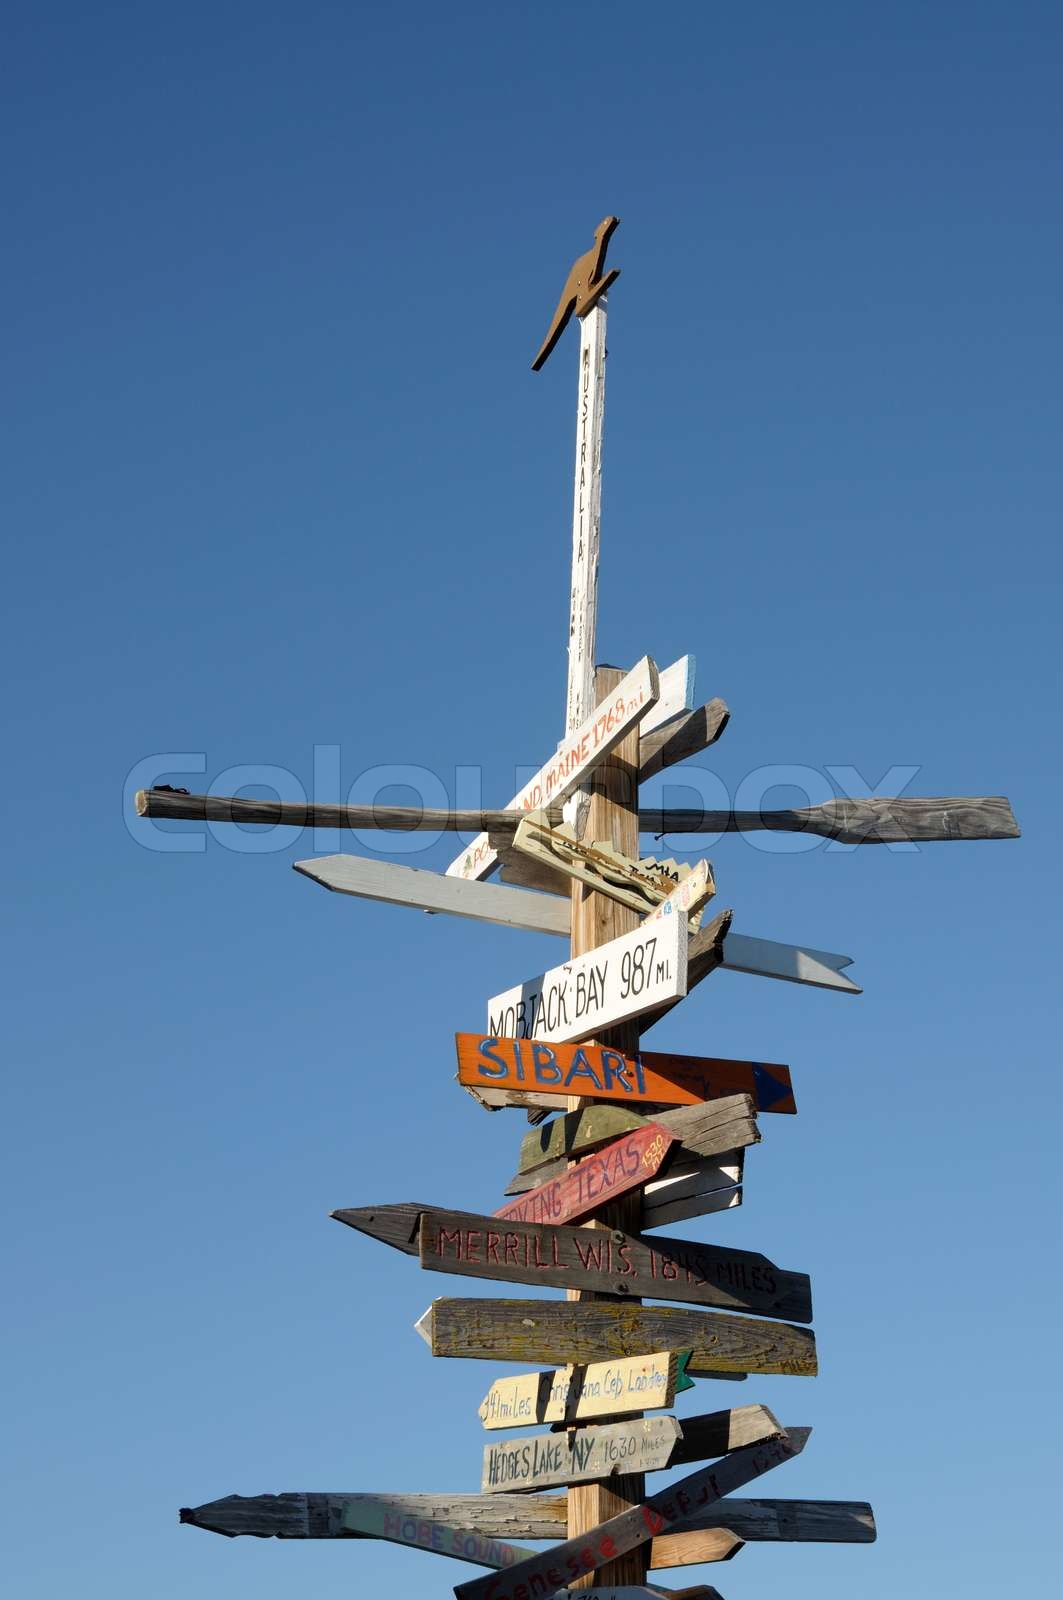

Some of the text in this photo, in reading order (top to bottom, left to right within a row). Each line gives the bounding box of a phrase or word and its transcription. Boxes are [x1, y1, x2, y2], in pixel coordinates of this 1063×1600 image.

[546, 734, 590, 796] MAINE
[592, 697, 626, 749] 1768
[575, 961, 609, 1020] BAY
[620, 937, 657, 1000] 987
[477, 1036, 648, 1094] SIBARI
[569, 1138, 641, 1204] TEXAS
[436, 1226, 570, 1271] MERRILL
[714, 1260, 778, 1296] MILES
[488, 1445, 530, 1486] HEDGES
[570, 1437, 596, 1475] NY
[604, 1436, 637, 1462] 1630
[383, 1512, 517, 1568] HOBE SOUND
